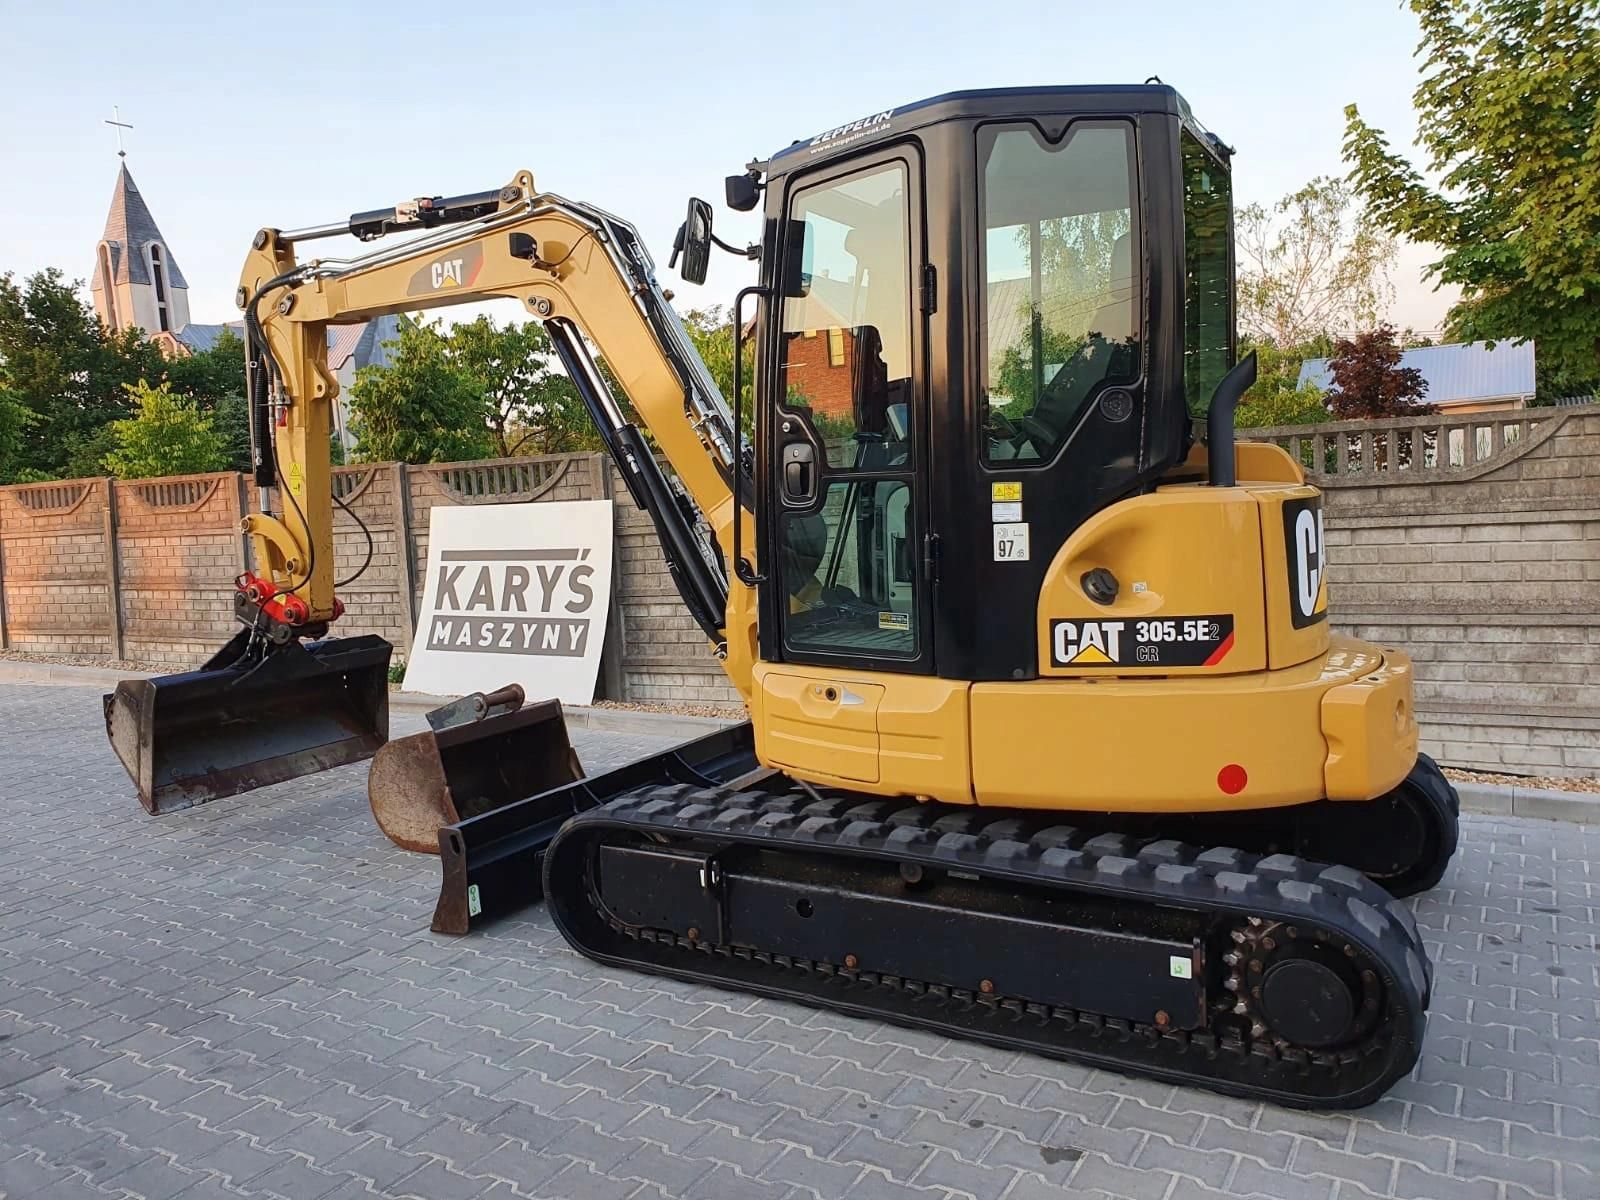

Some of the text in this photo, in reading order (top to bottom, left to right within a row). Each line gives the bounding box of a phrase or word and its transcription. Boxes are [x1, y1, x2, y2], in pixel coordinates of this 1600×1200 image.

[809, 110, 894, 146] ZEPPELIN
[431, 259, 463, 289] CAT
[998, 540, 1014, 557] 97
[434, 548, 595, 613] KARYŚ
[432, 620, 584, 650] MASZYNY
[1054, 621, 1125, 663] CAT
[1136, 645, 1159, 662] CR
